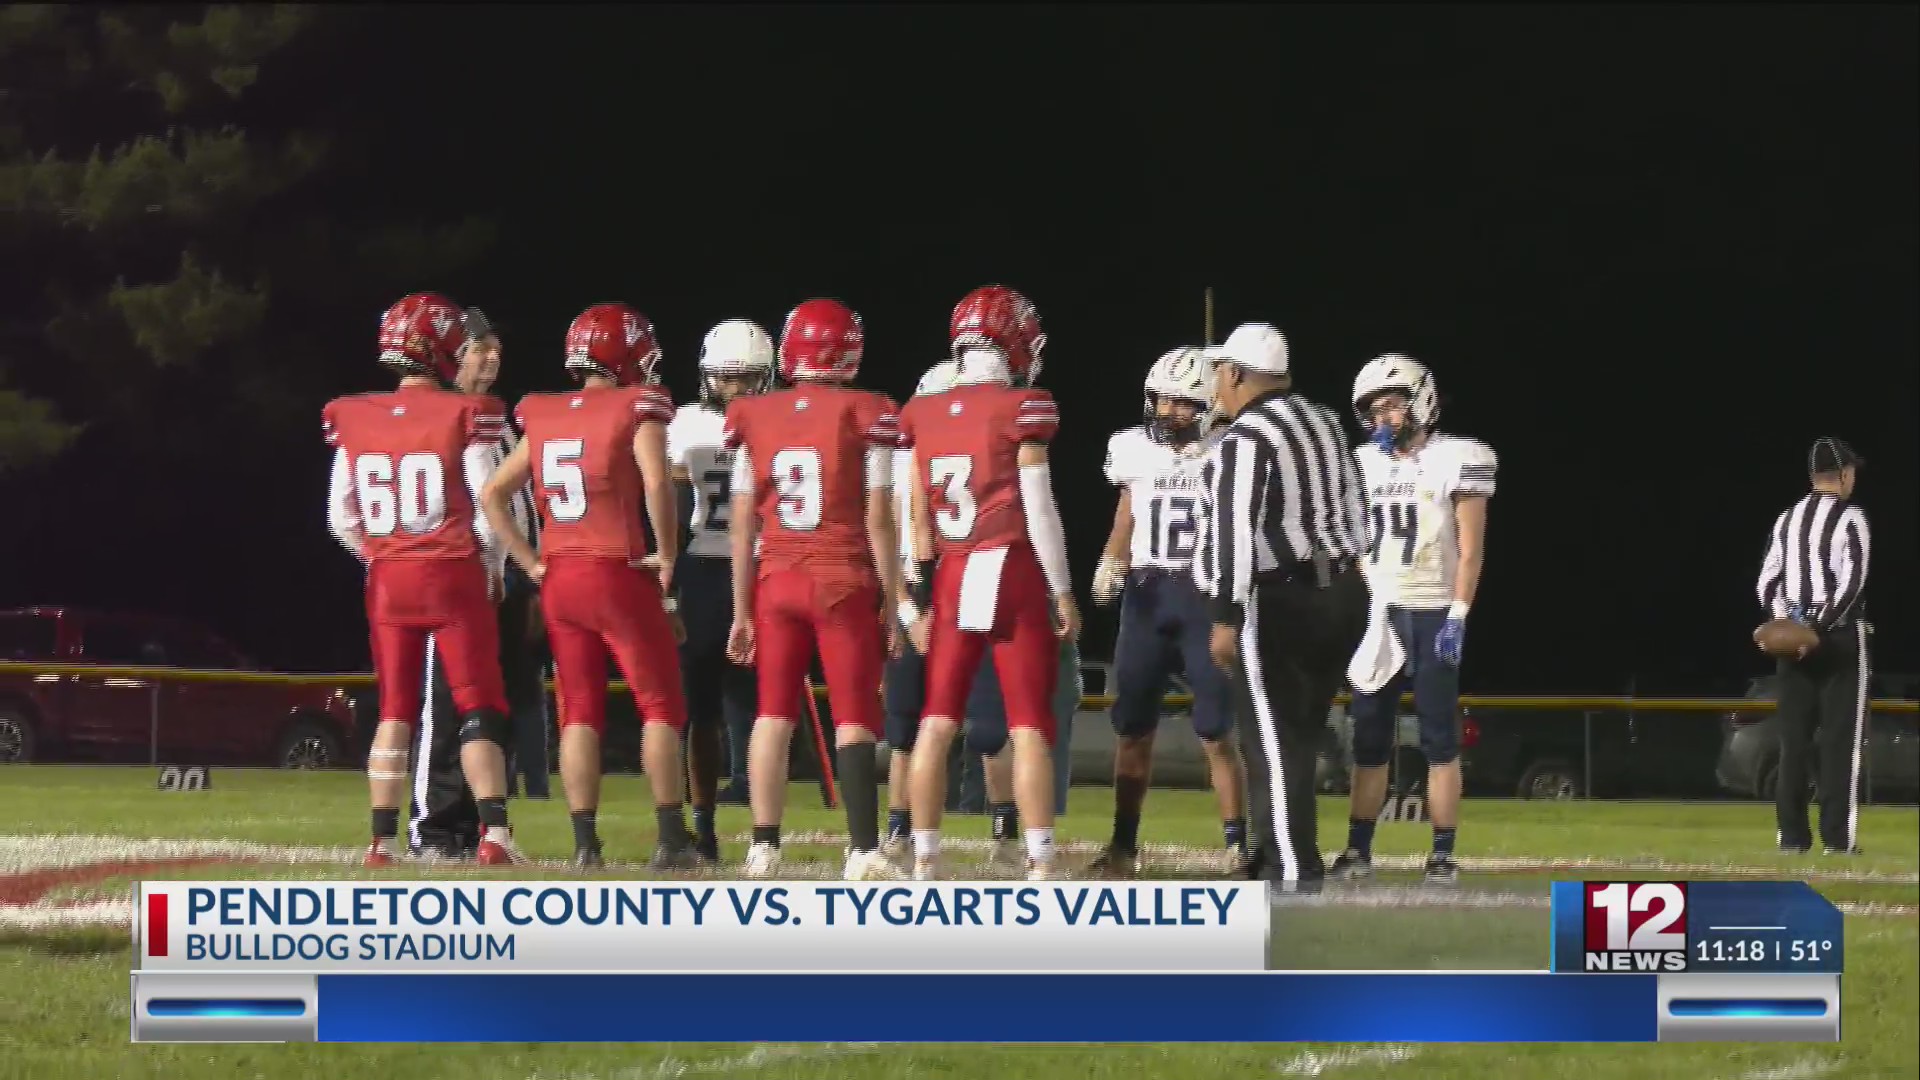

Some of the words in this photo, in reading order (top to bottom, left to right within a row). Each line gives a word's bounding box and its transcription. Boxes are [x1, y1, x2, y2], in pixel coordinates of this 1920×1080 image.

[355, 452, 447, 536] 60
[542, 438, 587, 521] 5
[771, 446, 823, 530] 9
[928, 454, 977, 541] 3
[1150, 497, 1198, 560] 12
